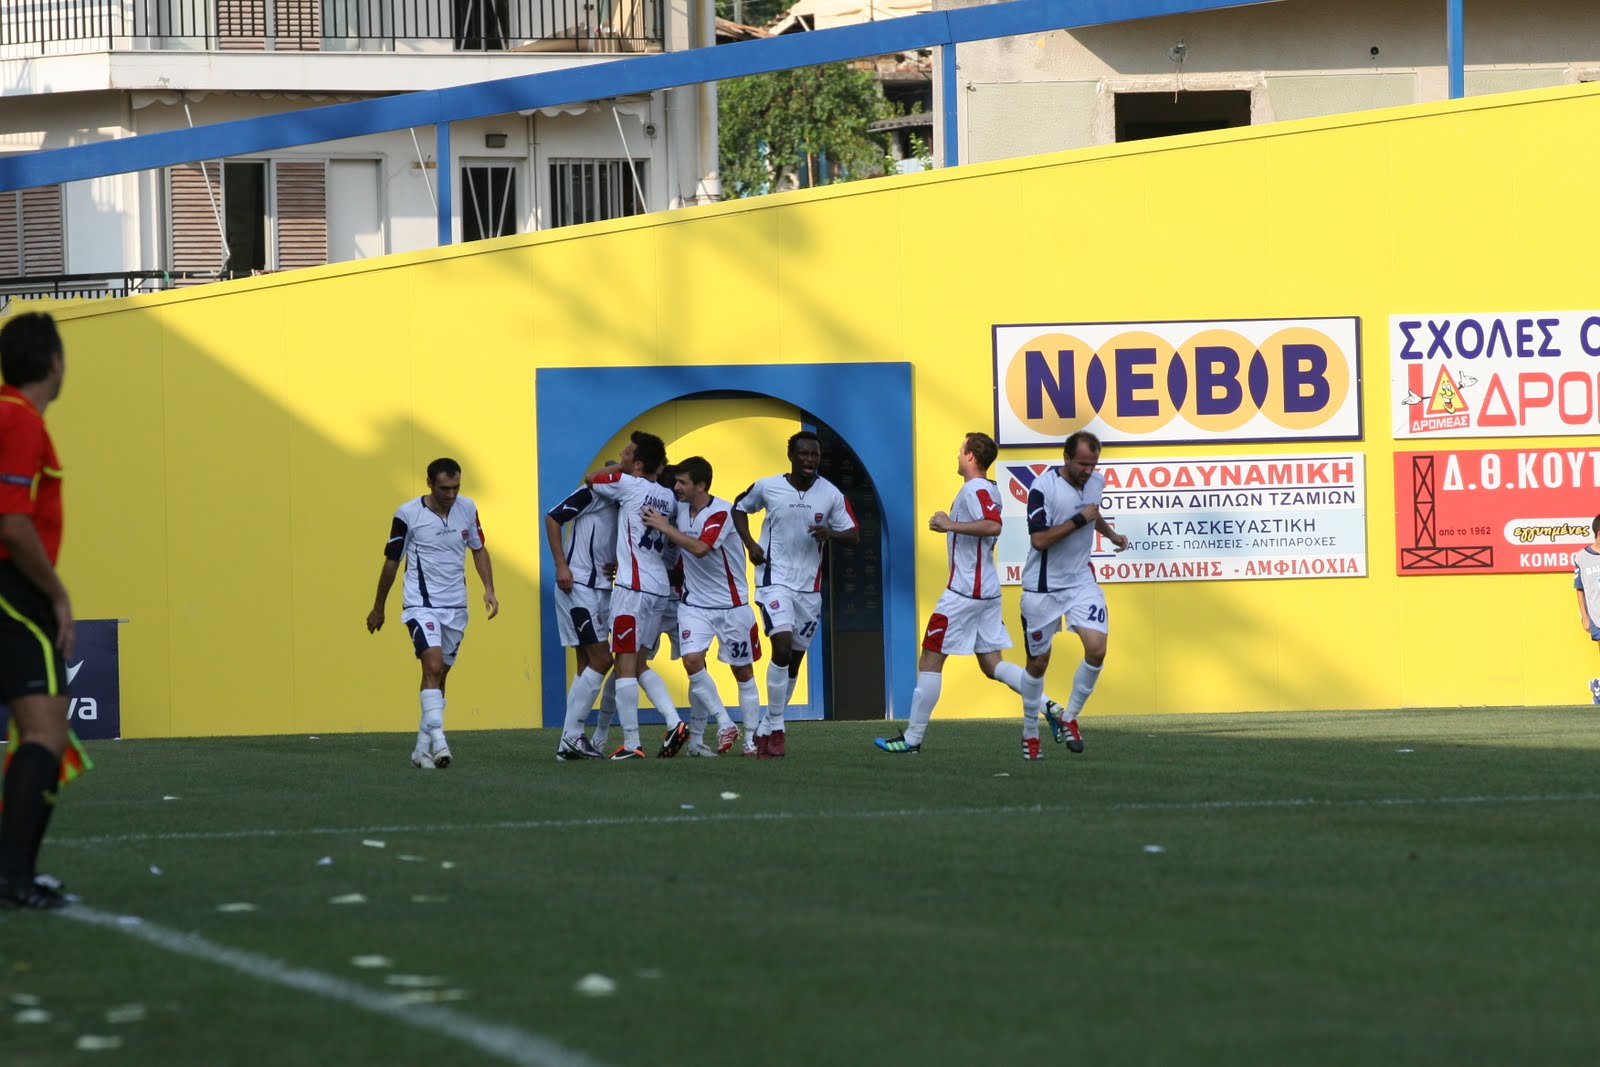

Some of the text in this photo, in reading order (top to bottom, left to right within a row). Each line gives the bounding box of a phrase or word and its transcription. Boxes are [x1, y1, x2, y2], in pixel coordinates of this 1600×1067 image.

[1399, 319, 1561, 359] ΣΧΟΛΕΣ
[1477, 371, 1600, 426] ΔΡΟ
[1412, 416, 1469, 431] ΔΡΟΜΕΑΣ
[1097, 462, 1353, 489] ΑΛΟΔΥΝΑΜΙΚΗ
[1100, 494, 1184, 510] ΟΤΕΧΝΙΑ
[1189, 493, 1262, 508] ΔΙΠΛΩΝ
[1268, 490, 1355, 506] ΤΖΑΜΙΩΝ
[1147, 518, 1315, 536] ΚΑΤΑΣΚΕΥΑΣΤΙΚΗ
[1470, 526, 1491, 536] 1962
[1127, 540, 1174, 551] ΑΓΟΡΕΣ
[1183, 539, 1243, 550] ΠΩΛΗΣΕΙΣ
[1252, 536, 1337, 548] ΑΝΤΙΠΑΡΟΧΕΣ
[1520, 552, 1578, 567] ΚΟΜΒΟ
[1099, 561, 1223, 580] ΦΟΥΡΛΑΝΗΣ
[1245, 558, 1359, 576] ΑΜΦΙΛΟΧΙΑ
[1088, 604, 1105, 624] 20
[800, 620, 817, 638] 15
[731, 641, 749, 658] 32
